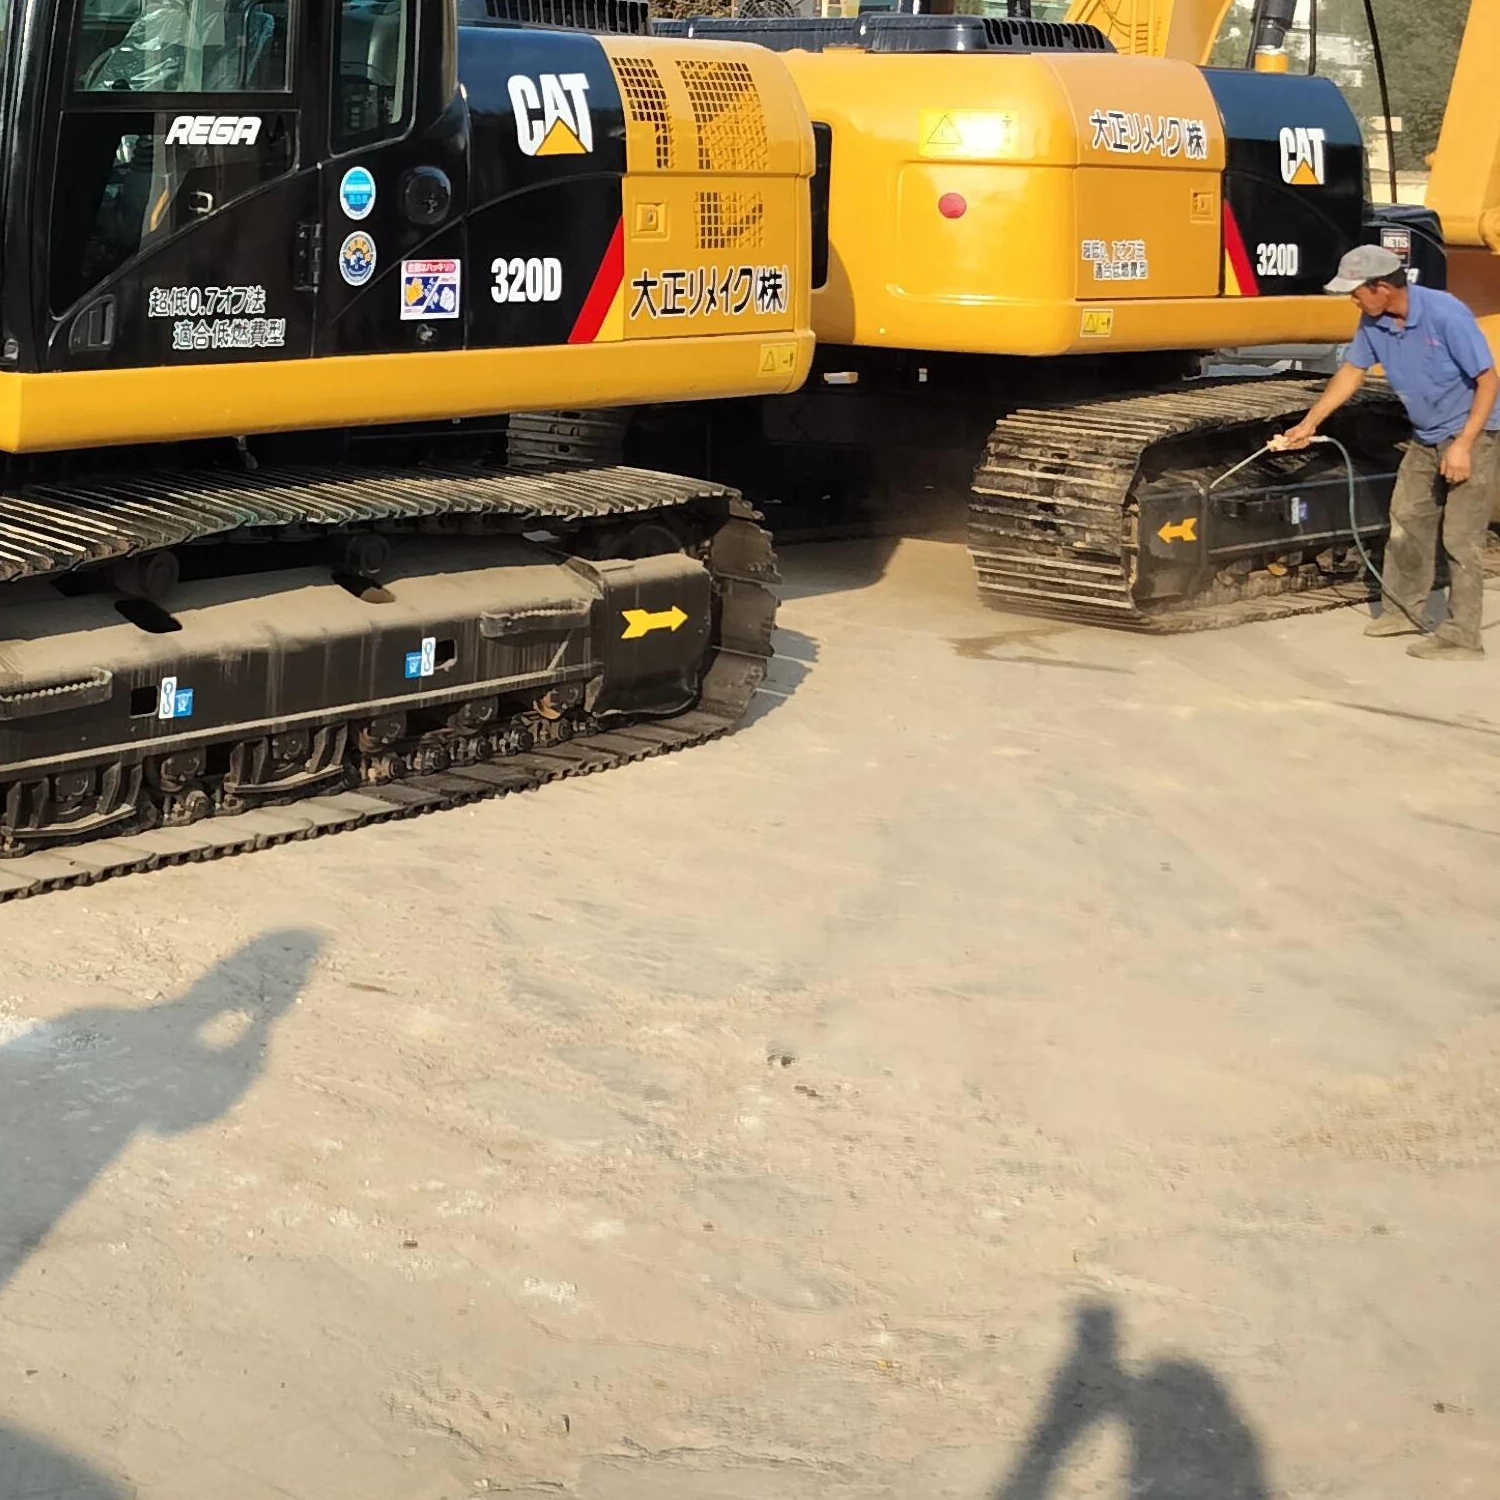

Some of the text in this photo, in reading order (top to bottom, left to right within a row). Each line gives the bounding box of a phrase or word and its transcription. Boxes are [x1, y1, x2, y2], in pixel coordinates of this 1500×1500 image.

[165, 115, 262, 145] REGA
[507, 72, 594, 157] CAT
[1279, 127, 1326, 185] CAT
[490, 257, 562, 303] 320D
[1256, 243, 1299, 277] 320D
